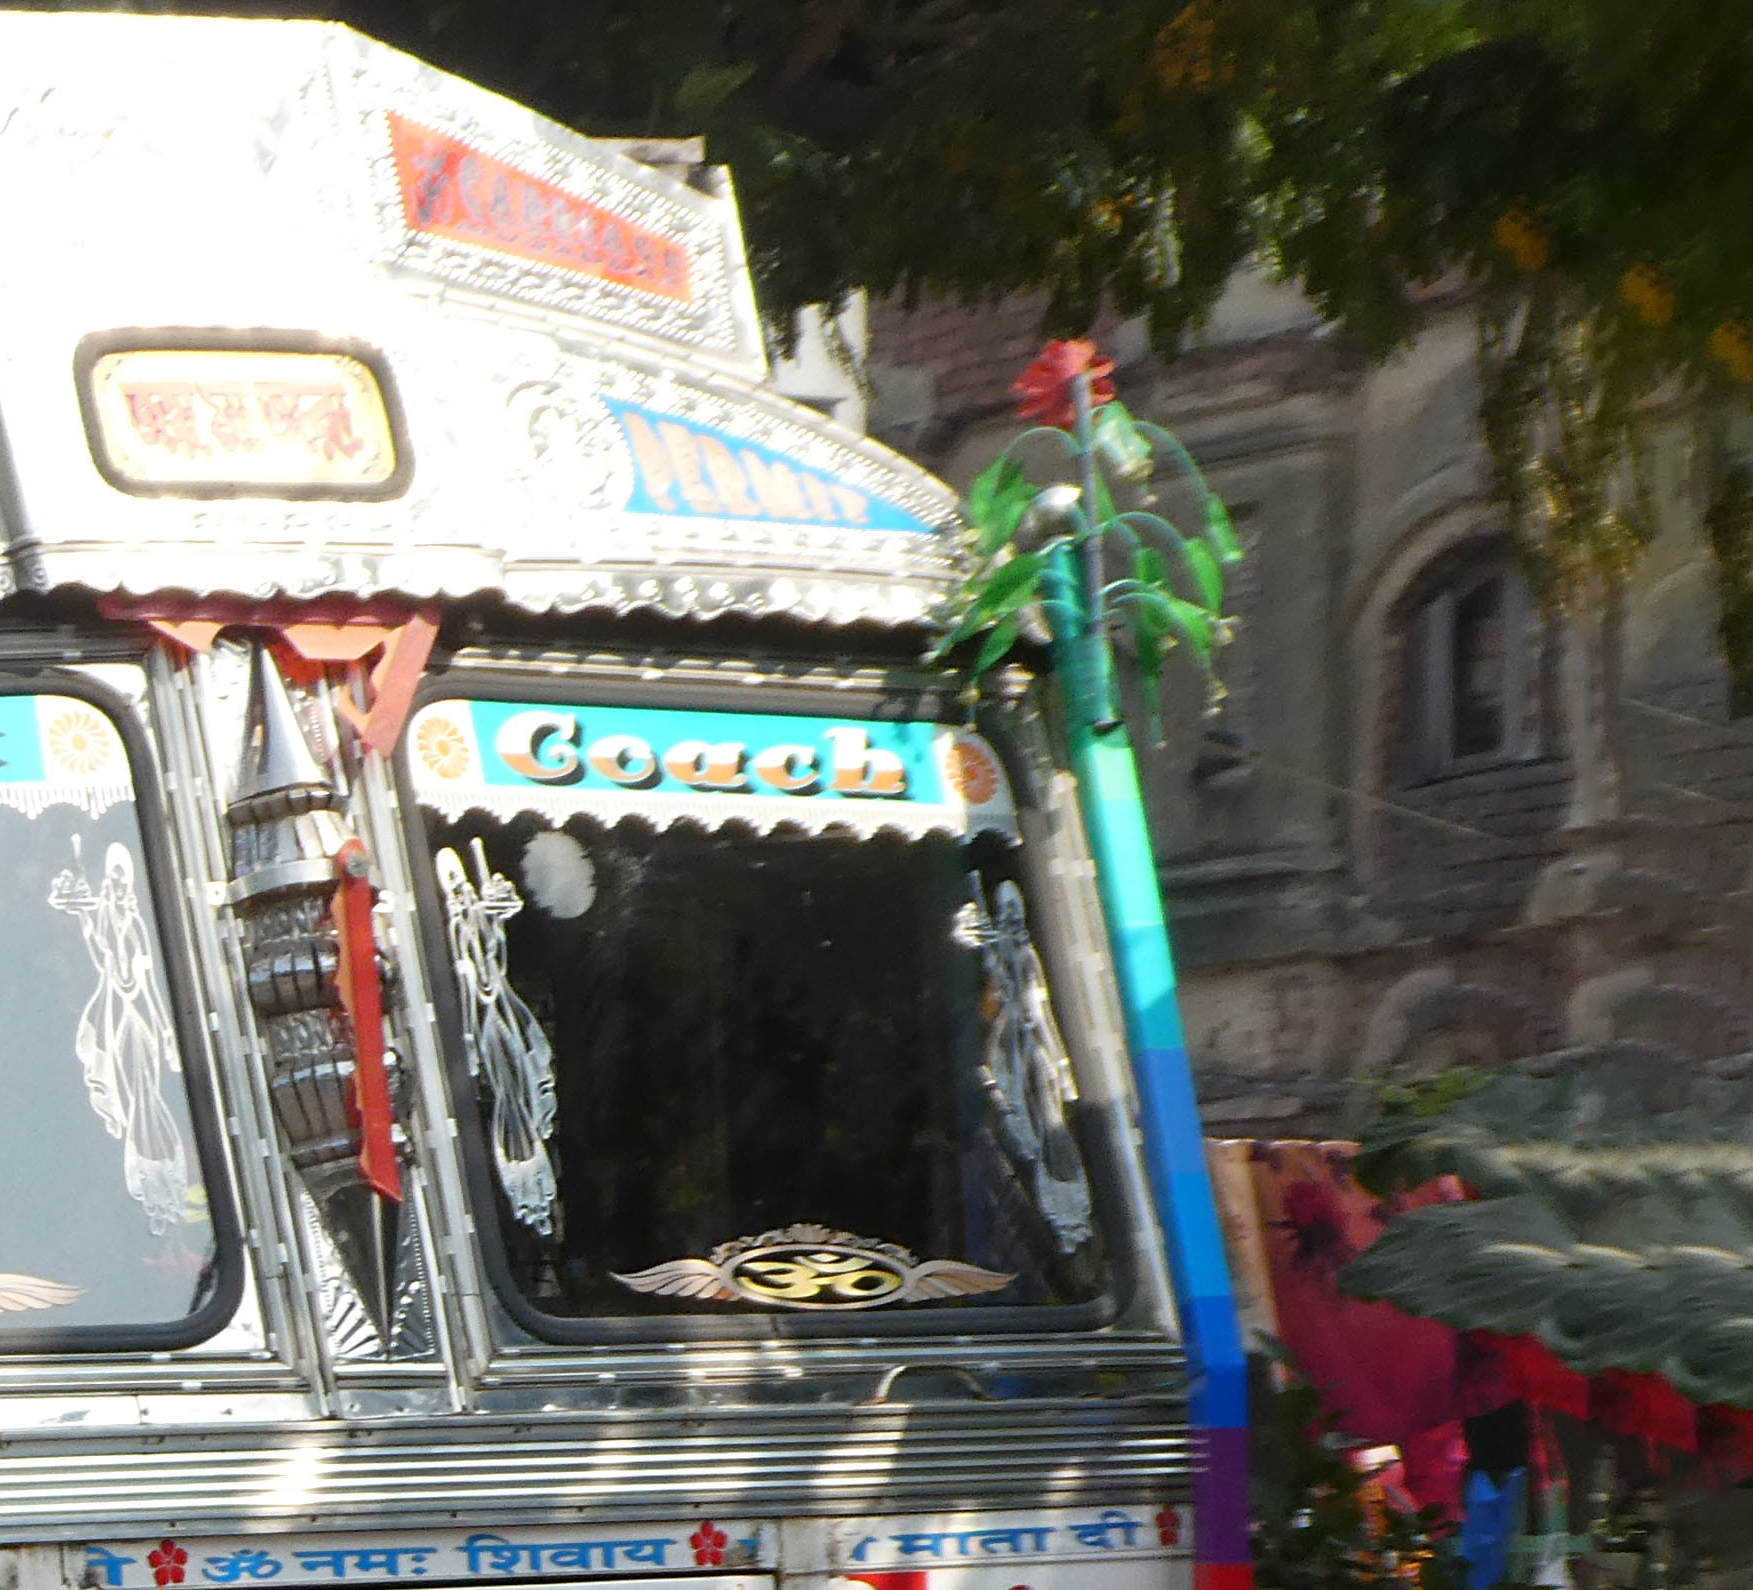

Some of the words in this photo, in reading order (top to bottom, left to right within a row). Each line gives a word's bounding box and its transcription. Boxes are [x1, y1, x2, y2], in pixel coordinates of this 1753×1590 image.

[623, 411, 870, 524] PERMIT
[496, 709, 913, 799] Coach
[293, 1545, 438, 1578] नमः
[459, 1532, 678, 1576] शिवाय
[891, 1525, 1055, 1560] माता
[1066, 1510, 1147, 1549] दी
